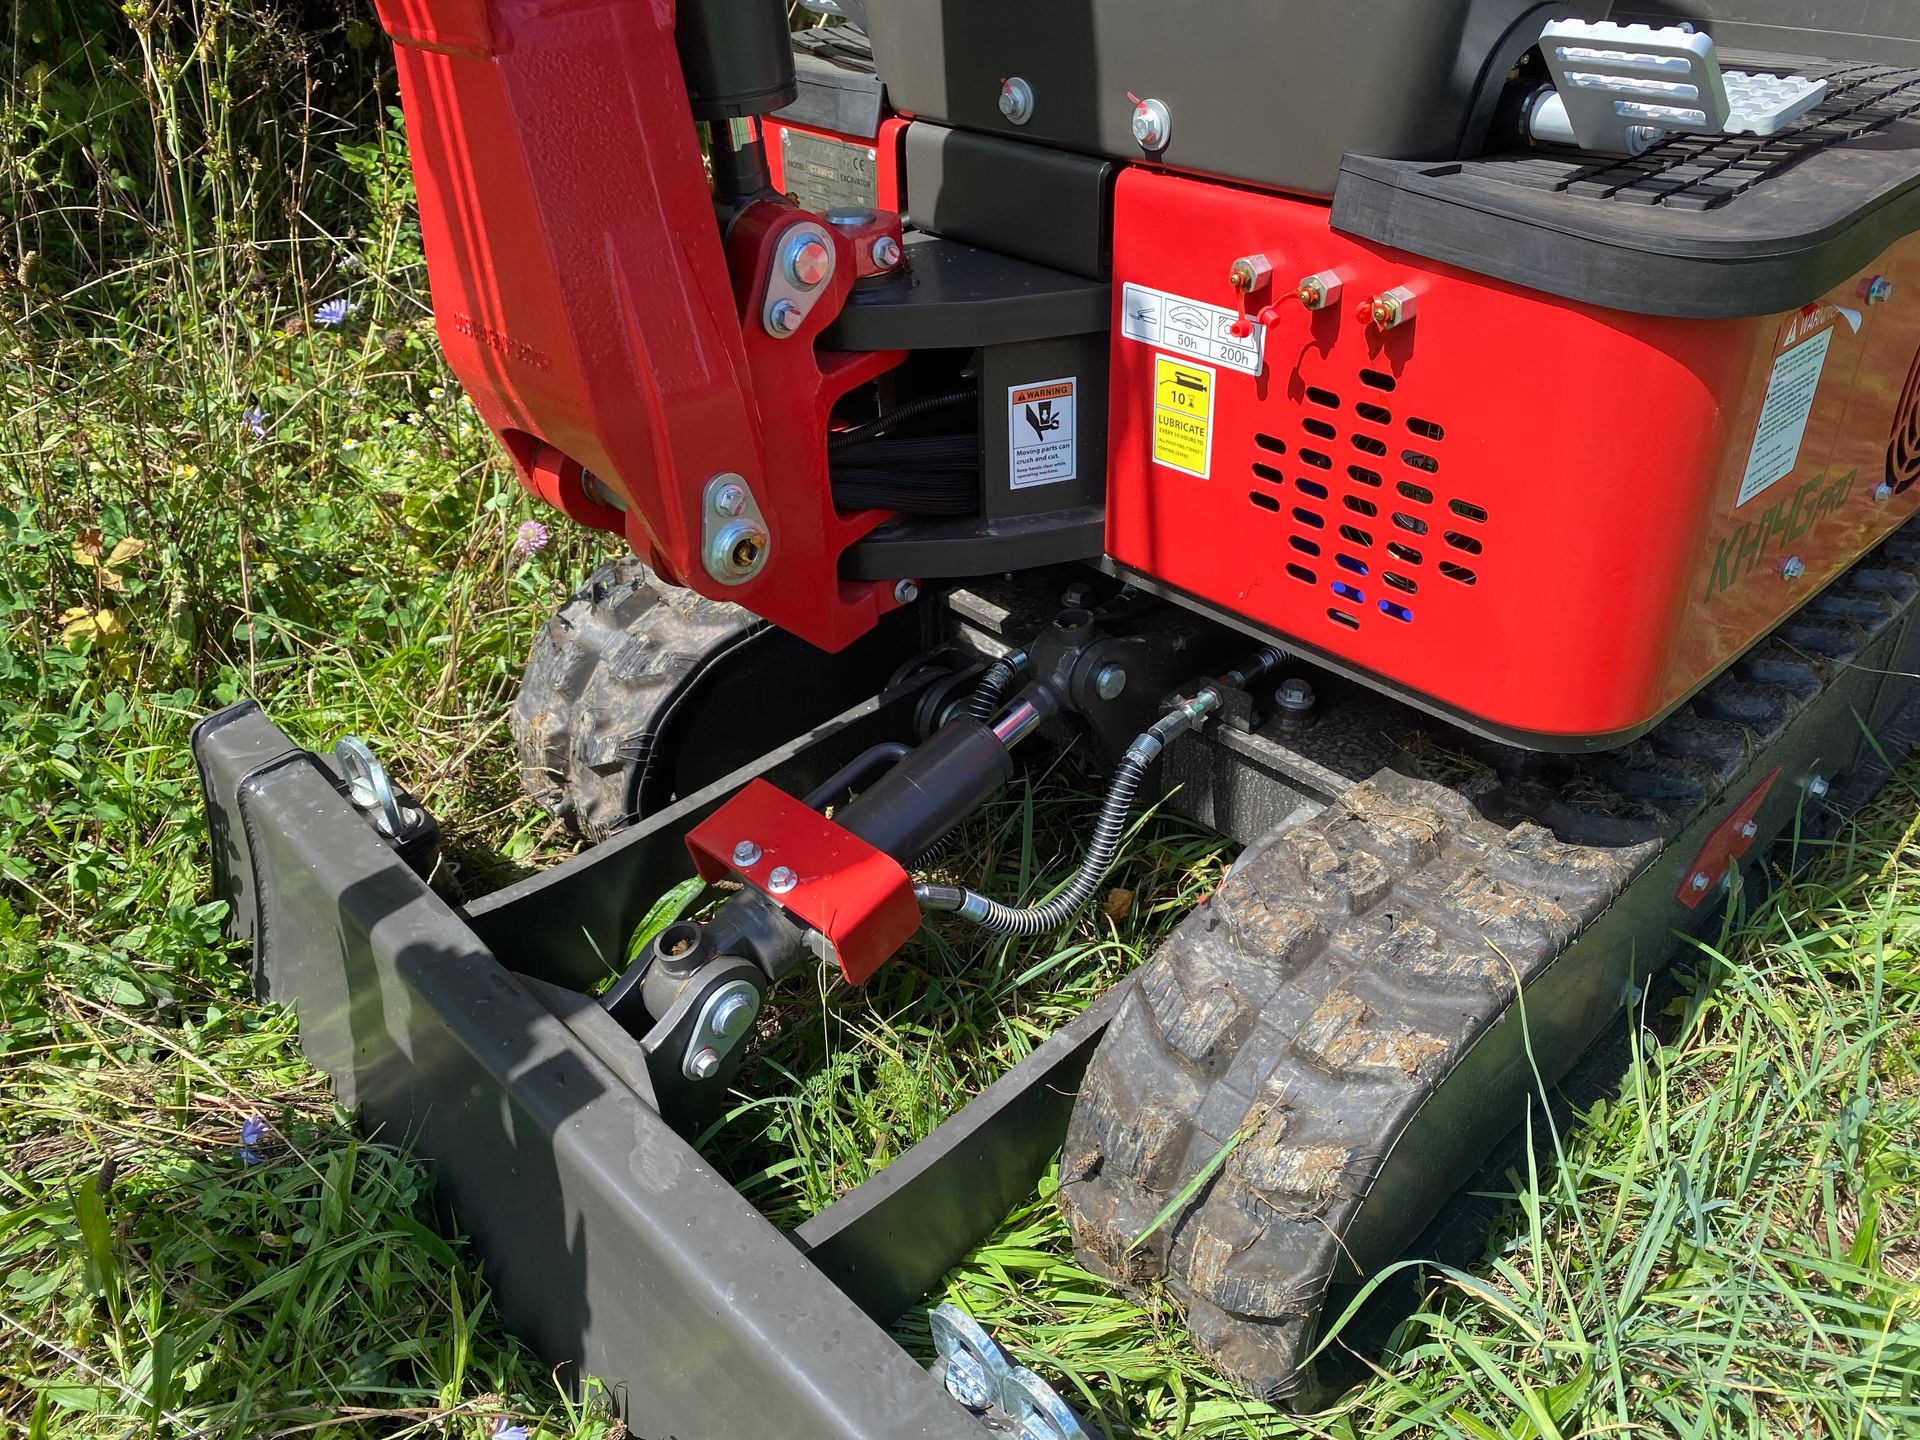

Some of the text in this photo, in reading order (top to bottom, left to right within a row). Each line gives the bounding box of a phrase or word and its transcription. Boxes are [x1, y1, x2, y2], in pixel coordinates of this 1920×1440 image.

[788, 160, 805, 171] MODEL
[853, 158, 865, 172] CE
[840, 174, 871, 188] EXCAVATOR
[1177, 334, 1249, 366] 50h 200h
[1026, 386, 1068, 398] WARNING
[1171, 390, 1186, 405] 10
[1158, 414, 1205, 437] LUBRICATE
[1159, 428, 1173, 436] EVERY
[1180, 435, 1196, 444] HOURS
[1016, 448, 1040, 456] Moving
[1041, 445, 1057, 453] parts
[1035, 454, 1046, 462] and
